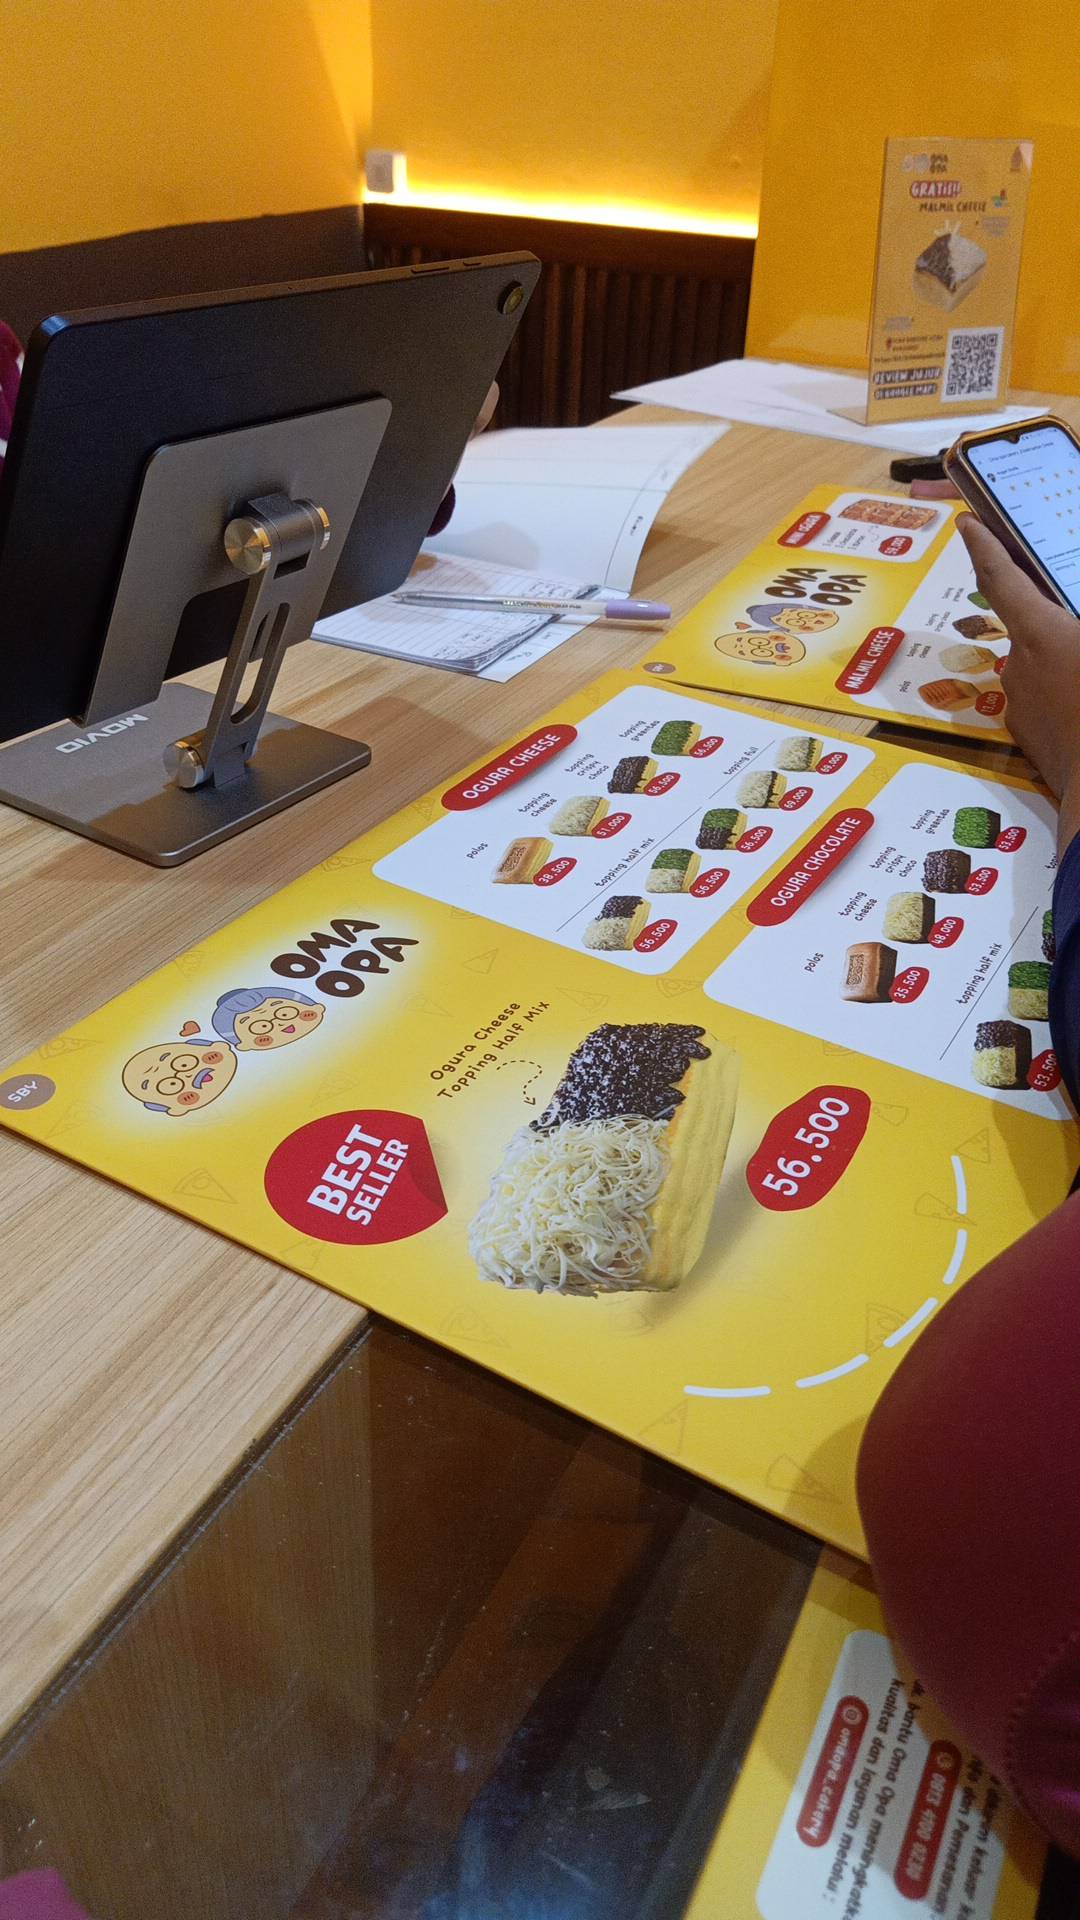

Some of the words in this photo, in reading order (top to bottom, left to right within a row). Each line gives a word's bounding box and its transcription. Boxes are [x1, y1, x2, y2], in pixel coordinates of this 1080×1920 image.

[764, 567, 828, 598] OMA
[811, 574, 868, 606] OPA
[845, 658, 876, 689] MALMIL
[867, 630, 895, 657] CHEESE
[619, 719, 646, 738] topping
[462, 766, 514, 799] OGURA
[510, 733, 561, 767] CHEESE
[565, 752, 594, 773] topping
[588, 764, 610, 780] choco
[819, 754, 843, 773] 69.000
[648, 774, 674, 794] 56.500
[518, 791, 551, 814] topping
[531, 798, 557, 818] cheese
[783, 788, 808, 809] 69.000
[596, 814, 625, 836] 51.000
[910, 808, 935, 831] topping
[926, 808, 950, 835] greentea
[467, 841, 489, 859] polos
[740, 828, 768, 851] 56.500
[1000, 827, 1020, 850] 53.500
[594, 861, 627, 888] topping
[624, 847, 645, 866] half
[640, 837, 655, 852] mix
[770, 869, 811, 907] OGURA
[805, 816, 861, 872] CHOCOLATE
[871, 846, 896, 870] topping
[885, 854, 906, 874] crispy
[899, 859, 918, 878] choco
[538, 860, 570, 884] 38.500
[694, 870, 724, 896] 56.500
[968, 868, 990, 893] 53.500
[838, 891, 867, 917] topping
[854, 897, 878, 922] cheese
[639, 922, 671, 950] 56.500
[934, 919, 957, 945] 48.000
[270, 918, 381, 979] OMA
[315, 936, 419, 998] OPA
[805, 951, 824, 973] polos
[957, 974, 984, 1005] topping
[979, 957, 996, 977] half
[990, 943, 1003, 960] mix
[895, 969, 921, 999] 35.500
[430, 1035, 476, 1082] Ogura
[473, 1000, 522, 1042] Cheese
[438, 1051, 498, 1098] Topping
[494, 1021, 526, 1052] Half
[520, 1000, 551, 1024] Mix
[8, 1079, 39, 1103] SBY
[762, 1096, 851, 1197] 56.500
[307, 1124, 386, 1214] BEST
[346, 1138, 410, 1226] SELLER
[876, 1679, 905, 1733] kualitas
[867, 1737, 885, 1764] dan
[846, 1767, 877, 1829] layanan
[875, 1786, 895, 1816] Opa
